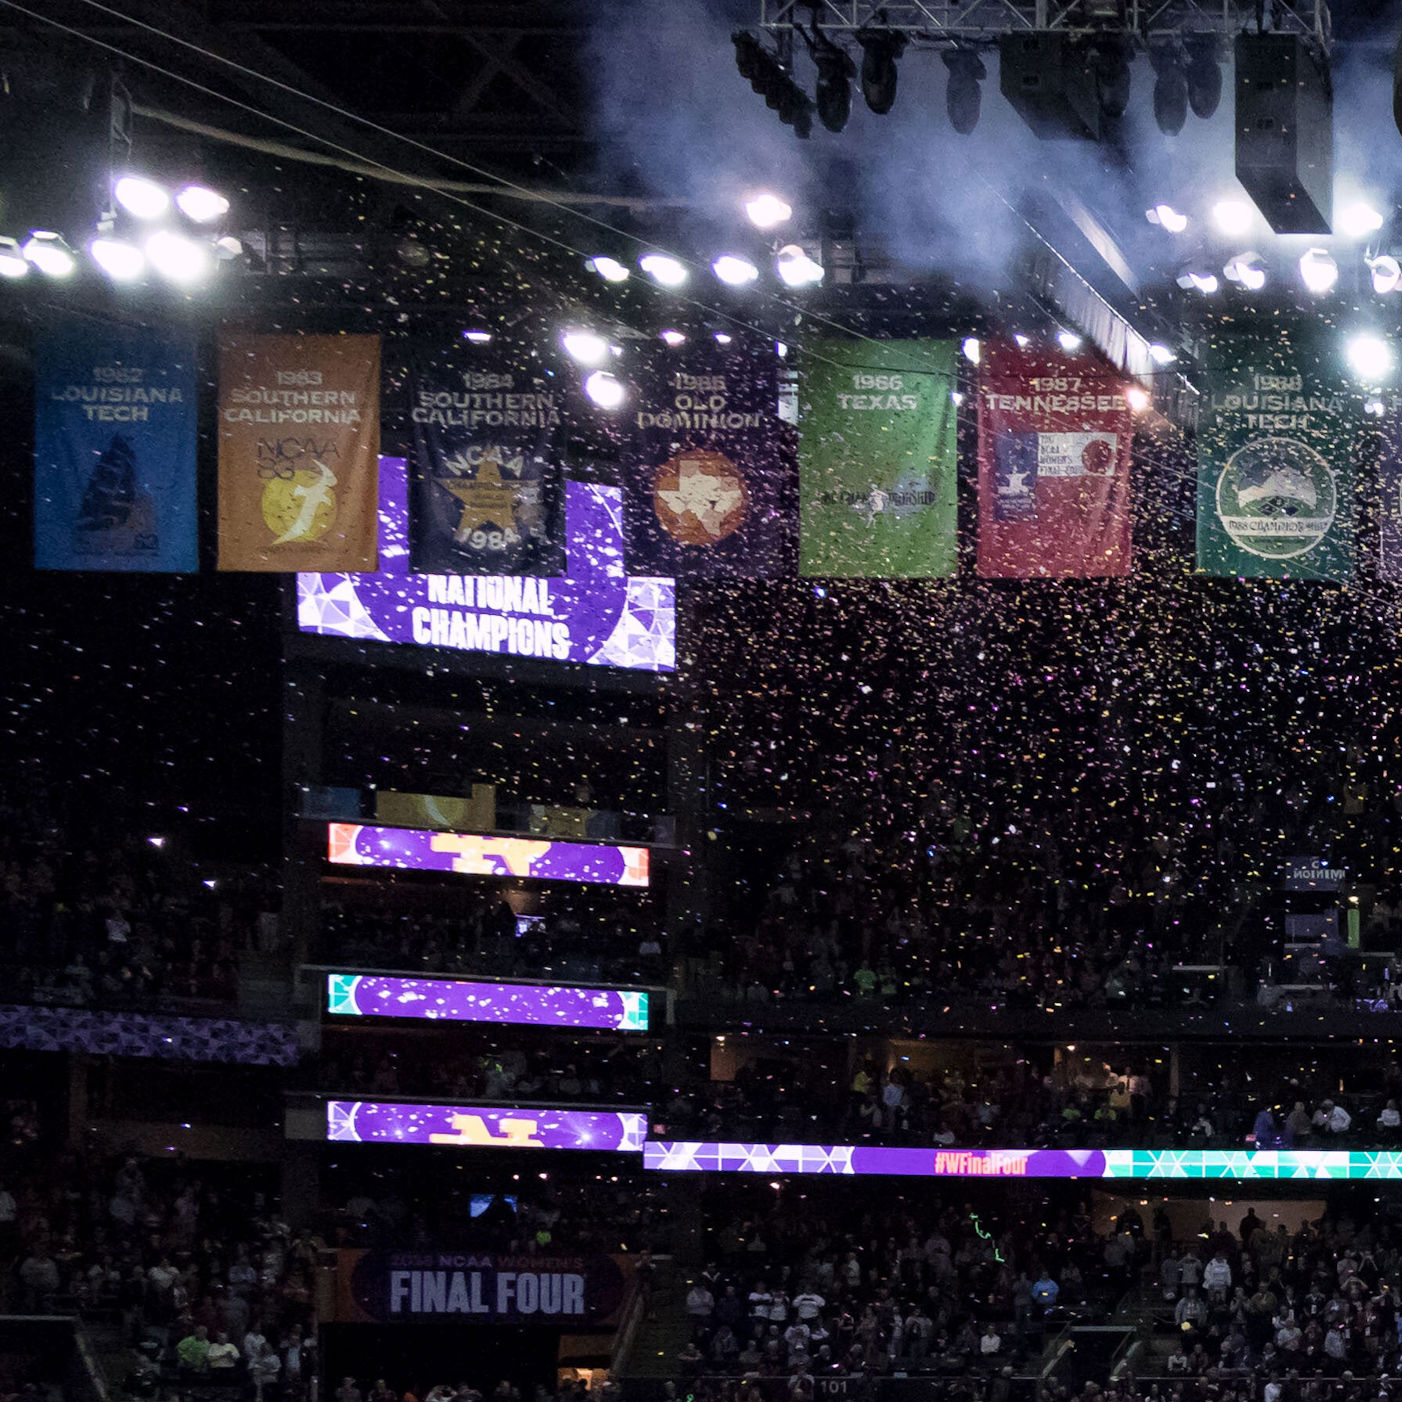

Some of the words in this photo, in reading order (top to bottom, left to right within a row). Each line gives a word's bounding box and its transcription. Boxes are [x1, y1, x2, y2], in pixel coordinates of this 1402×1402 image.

[278, 371, 323, 386] 1983
[1034, 377, 1082, 393] 1987
[51, 386, 183, 403] LOUISIANA
[233, 390, 356, 406] SOUTHERN
[419, 391, 553, 408] SOUTHERN
[675, 395, 727, 411] OLD
[838, 394, 917, 411] TEXAS
[987, 394, 1126, 411] TENNESSEE
[1211, 395, 1344, 412] LOUISIANA
[83, 405, 149, 421] TECH
[225, 408, 361, 424] CALIFORNIA
[412, 408, 561, 427] CALIFORNIA
[638, 412, 761, 430] DOMINION
[1248, 413, 1308, 430] TECH
[456, 528, 521, 551] 1984
[428, 576, 554, 616] NATIONAL
[412, 607, 571, 660] CHAMPIONS
[935, 1151, 1028, 1175] #WFinalFour
[438, 1256, 493, 1268] NCAA
[390, 1270, 490, 1314] FINAL
[497, 1271, 586, 1315] FOUR
[820, 1381, 848, 1394] 101
